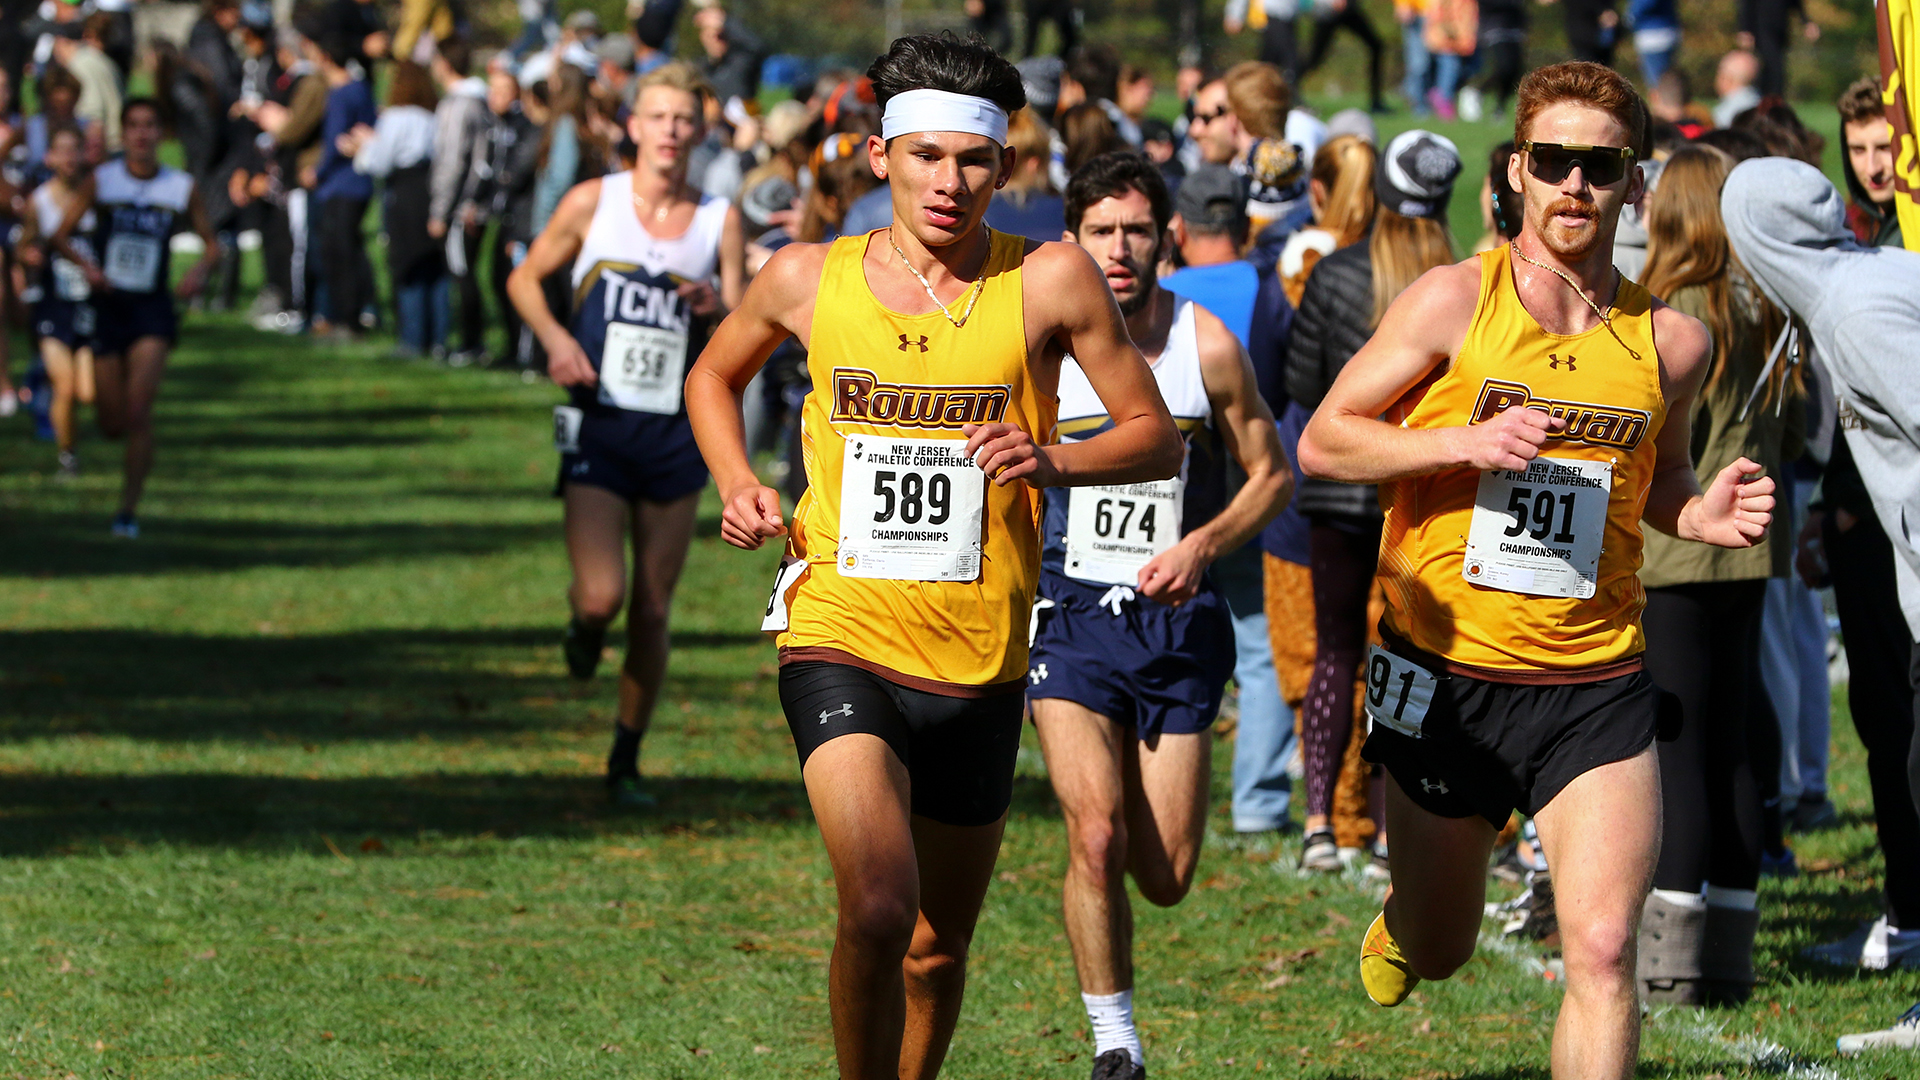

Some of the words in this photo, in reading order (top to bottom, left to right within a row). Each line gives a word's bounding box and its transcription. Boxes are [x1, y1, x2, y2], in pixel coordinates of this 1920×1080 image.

[830, 367, 1013, 430] Rowan
[891, 444, 913, 456] NEW
[915, 445, 951, 457] JERSEY
[867, 453, 911, 466] ATHLETIC
[913, 455, 975, 468] CONFERENCE
[1529, 462, 1549, 475] NEW
[1551, 464, 1583, 477] JERSEY
[1505, 472, 1547, 484] ATHLETIC
[1548, 475, 1602, 489] CONFERENCE
[873, 470, 951, 525] 589
[1095, 498, 1156, 543] 674
[1504, 487, 1576, 544] 591
[871, 529, 949, 543] CHAMPIONSHIPS
[1093, 542, 1154, 556] CHAMPIONSHIPS
[1499, 542, 1572, 560] CHAMPIONSHIPS
[1366, 647, 1416, 722] 91
